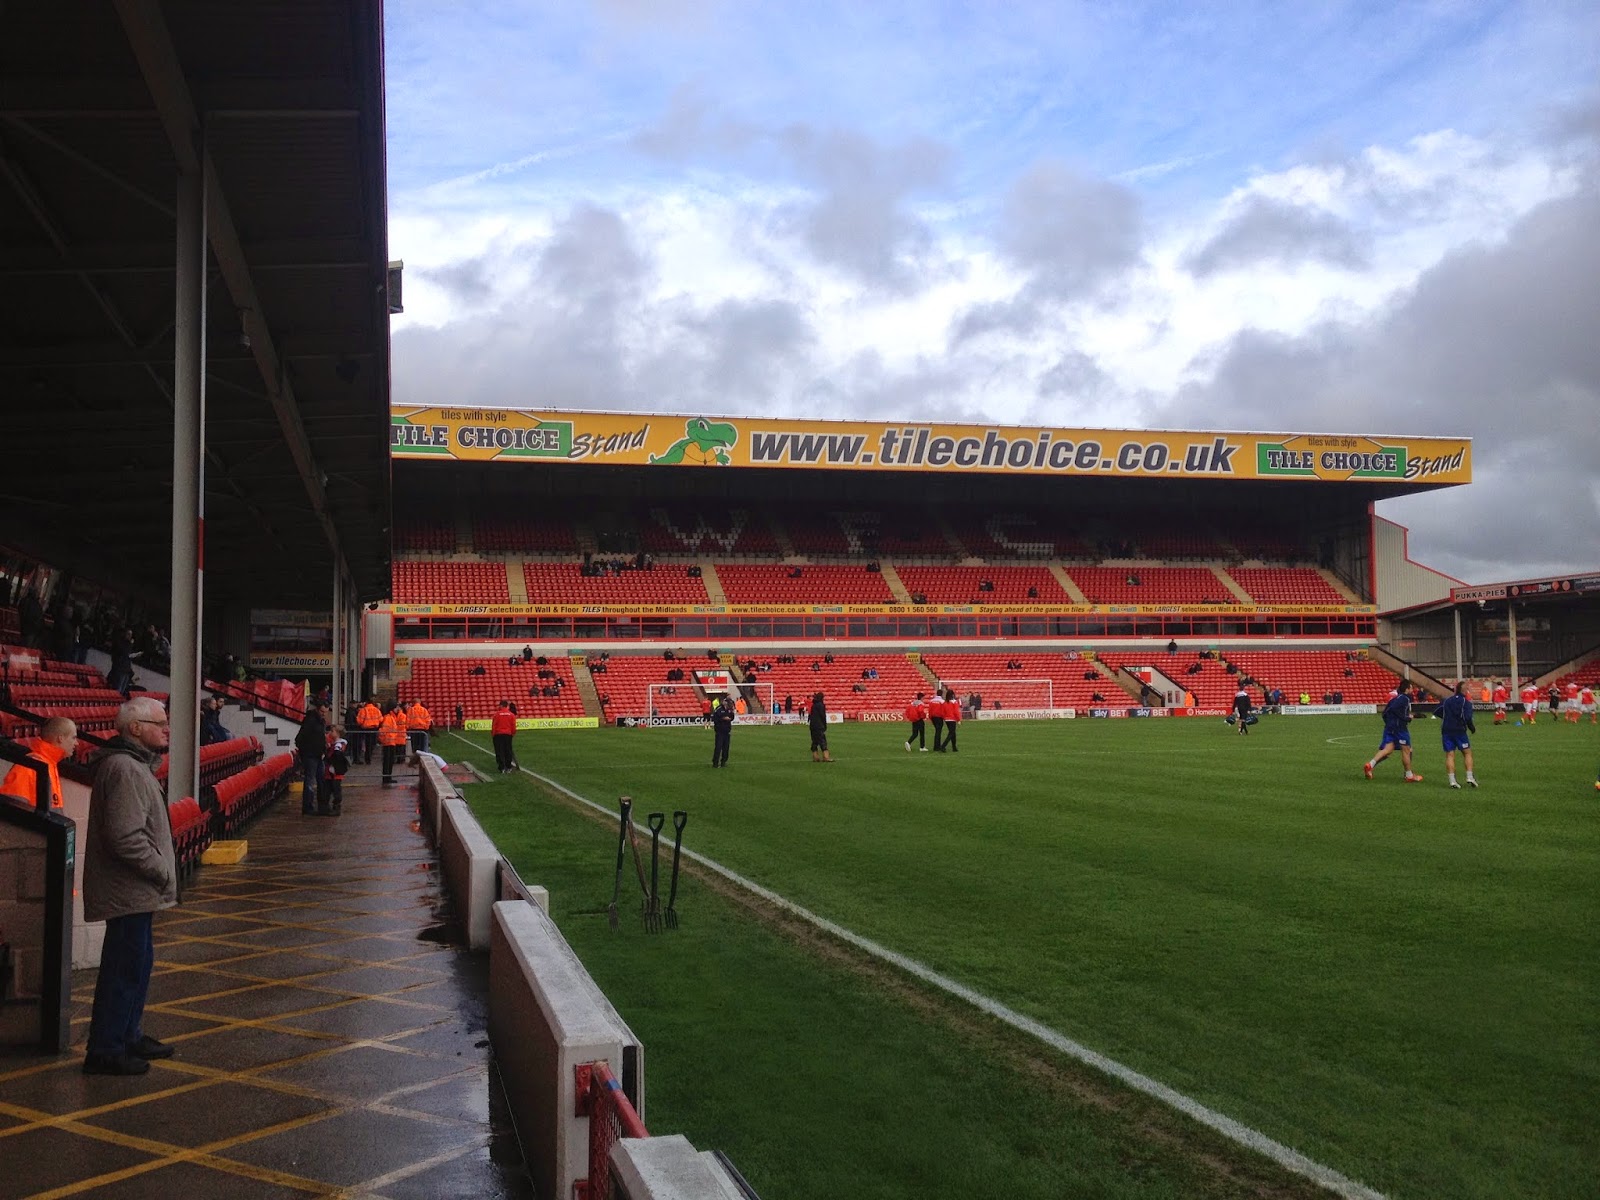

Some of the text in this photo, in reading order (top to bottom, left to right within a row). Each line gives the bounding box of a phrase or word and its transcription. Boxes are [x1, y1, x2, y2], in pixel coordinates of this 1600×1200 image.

[440, 410, 507, 424] tiles with style
[456, 426, 560, 450] CHOICE
[568, 423, 649, 461] Stand
[1308, 437, 1357, 448] tiles with style
[750, 427, 1240, 475] www.tilechoice.co.uk
[1267, 447, 1464, 479] TILE CHOICE Stand
[602, 606, 640, 614] throughout
[979, 606, 1003, 614] Staying
[994, 710, 1026, 719] Leamore
[1027, 709, 1060, 718] Windows
[1094, 709, 1108, 718] sky
[1136, 708, 1150, 718] sky
